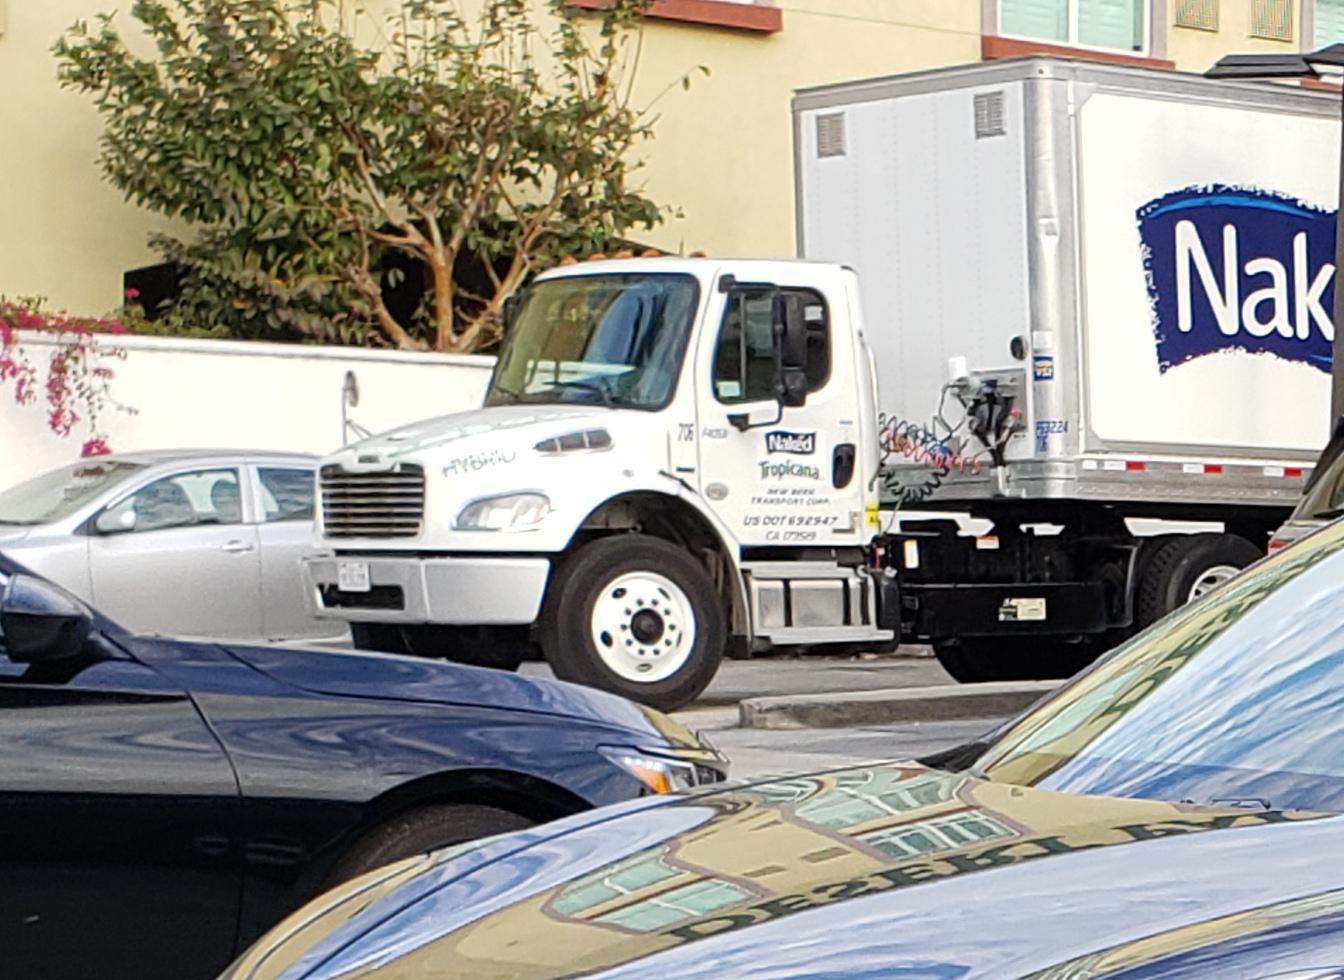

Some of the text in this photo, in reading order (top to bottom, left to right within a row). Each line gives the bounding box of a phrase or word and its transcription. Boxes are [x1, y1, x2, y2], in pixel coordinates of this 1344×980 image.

[768, 433, 813, 451] Naked
[758, 459, 821, 481] Tropicana
[751, 496, 805, 505] TRANSPORT
[743, 515, 760, 526] US
[762, 515, 787, 526] DOT
